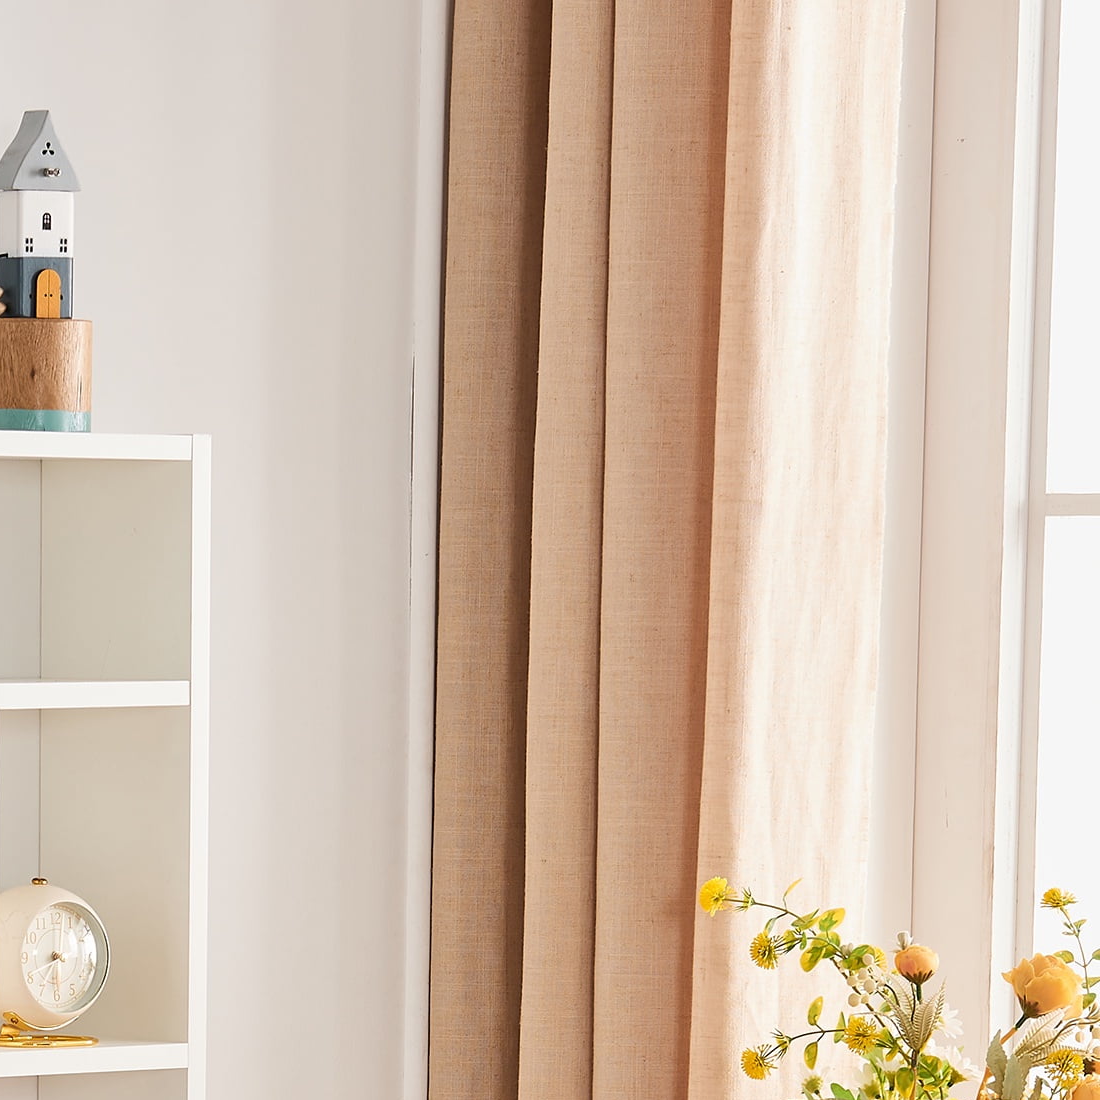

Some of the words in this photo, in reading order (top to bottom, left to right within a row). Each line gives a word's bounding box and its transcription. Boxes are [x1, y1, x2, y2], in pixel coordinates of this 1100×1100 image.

[36, 918, 47, 930] 11
[51, 912, 61, 925] 12
[25, 932, 37, 945] 10
